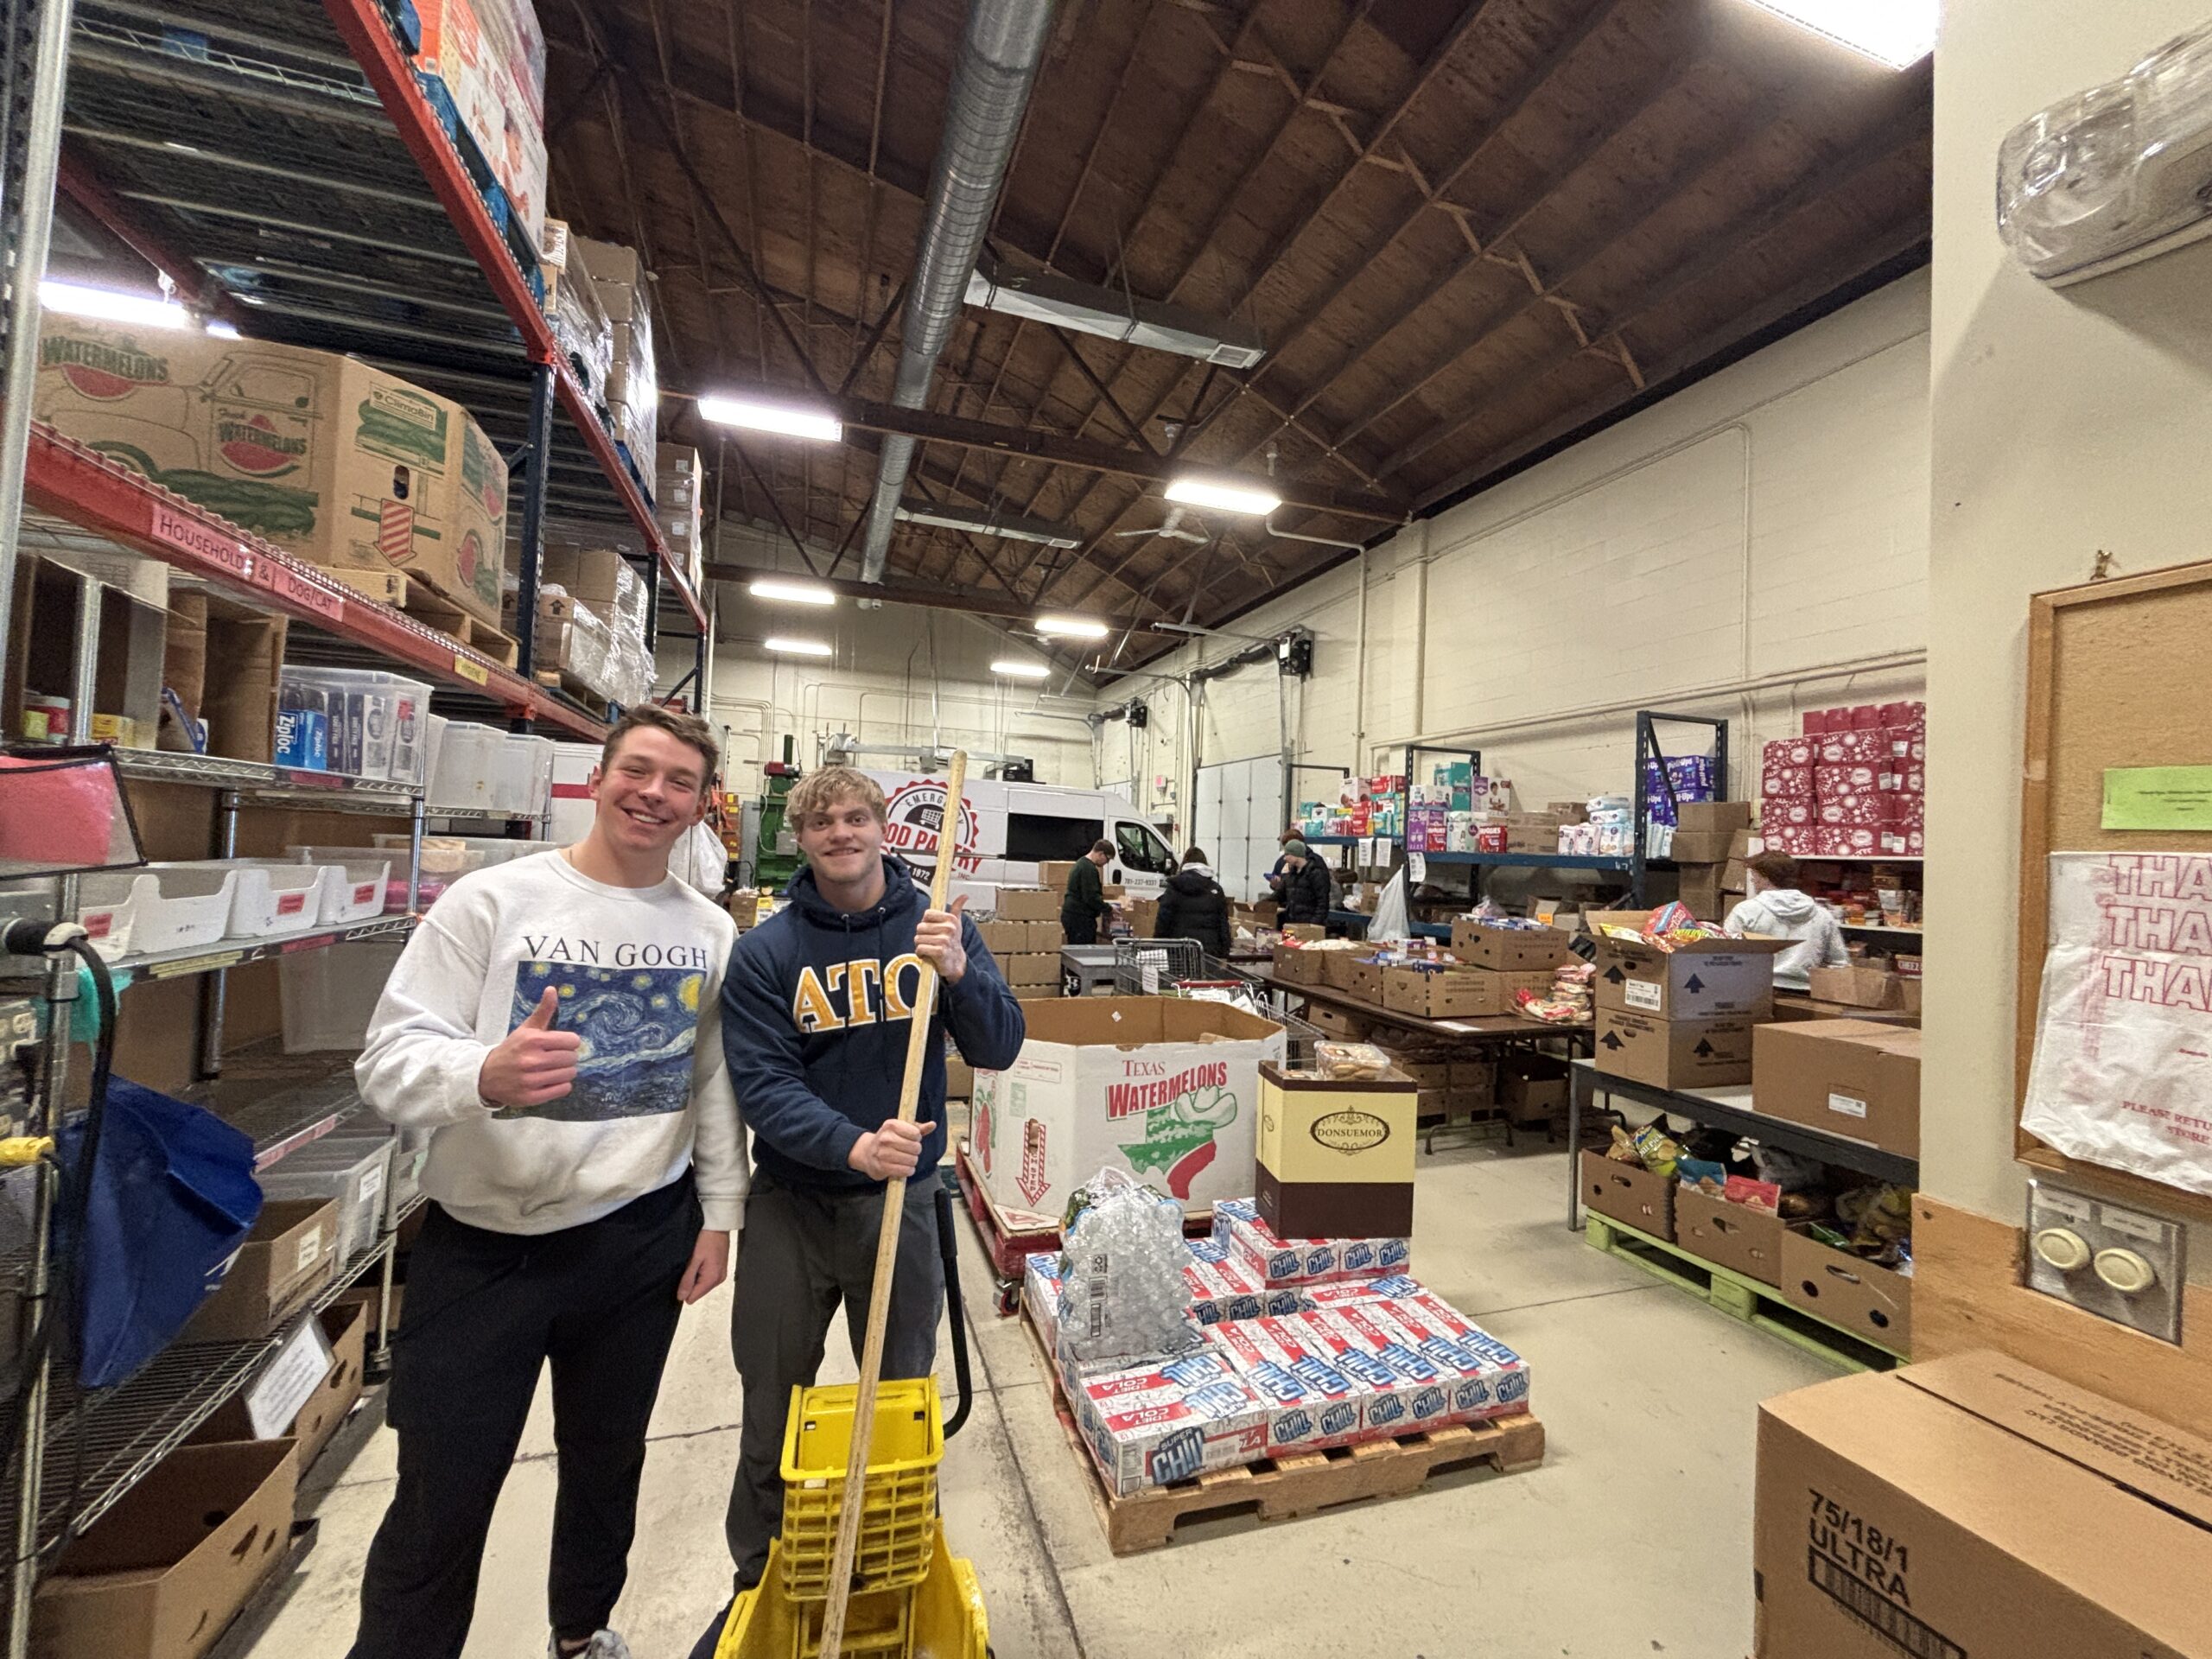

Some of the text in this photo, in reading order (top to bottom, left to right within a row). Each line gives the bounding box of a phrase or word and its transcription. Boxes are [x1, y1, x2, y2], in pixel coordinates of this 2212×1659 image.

[219, 422, 308, 454] WATERMELONS
[160, 514, 334, 610] HOUSEHOLD & DOG/CAT
[276, 715, 296, 755] Ziploc
[912, 867, 931, 880] 1972
[524, 935, 708, 969] VAN GOGH
[1122, 1059, 1166, 1077] TEXAS
[1108, 1061, 1228, 1118] WATERMELONS
[1317, 1128, 1382, 1138] DONSUEMOR
[1102, 1377, 1148, 1392] COLA
[1114, 1383, 1141, 1395] DIET
[1122, 1407, 1170, 1423] COLA
[1133, 1415, 1163, 1427] DIET
[1160, 1427, 1193, 1452] SUPER
[1808, 1487, 1909, 1573] 75/18/1
[1809, 1517, 1911, 1609] ULTRA
